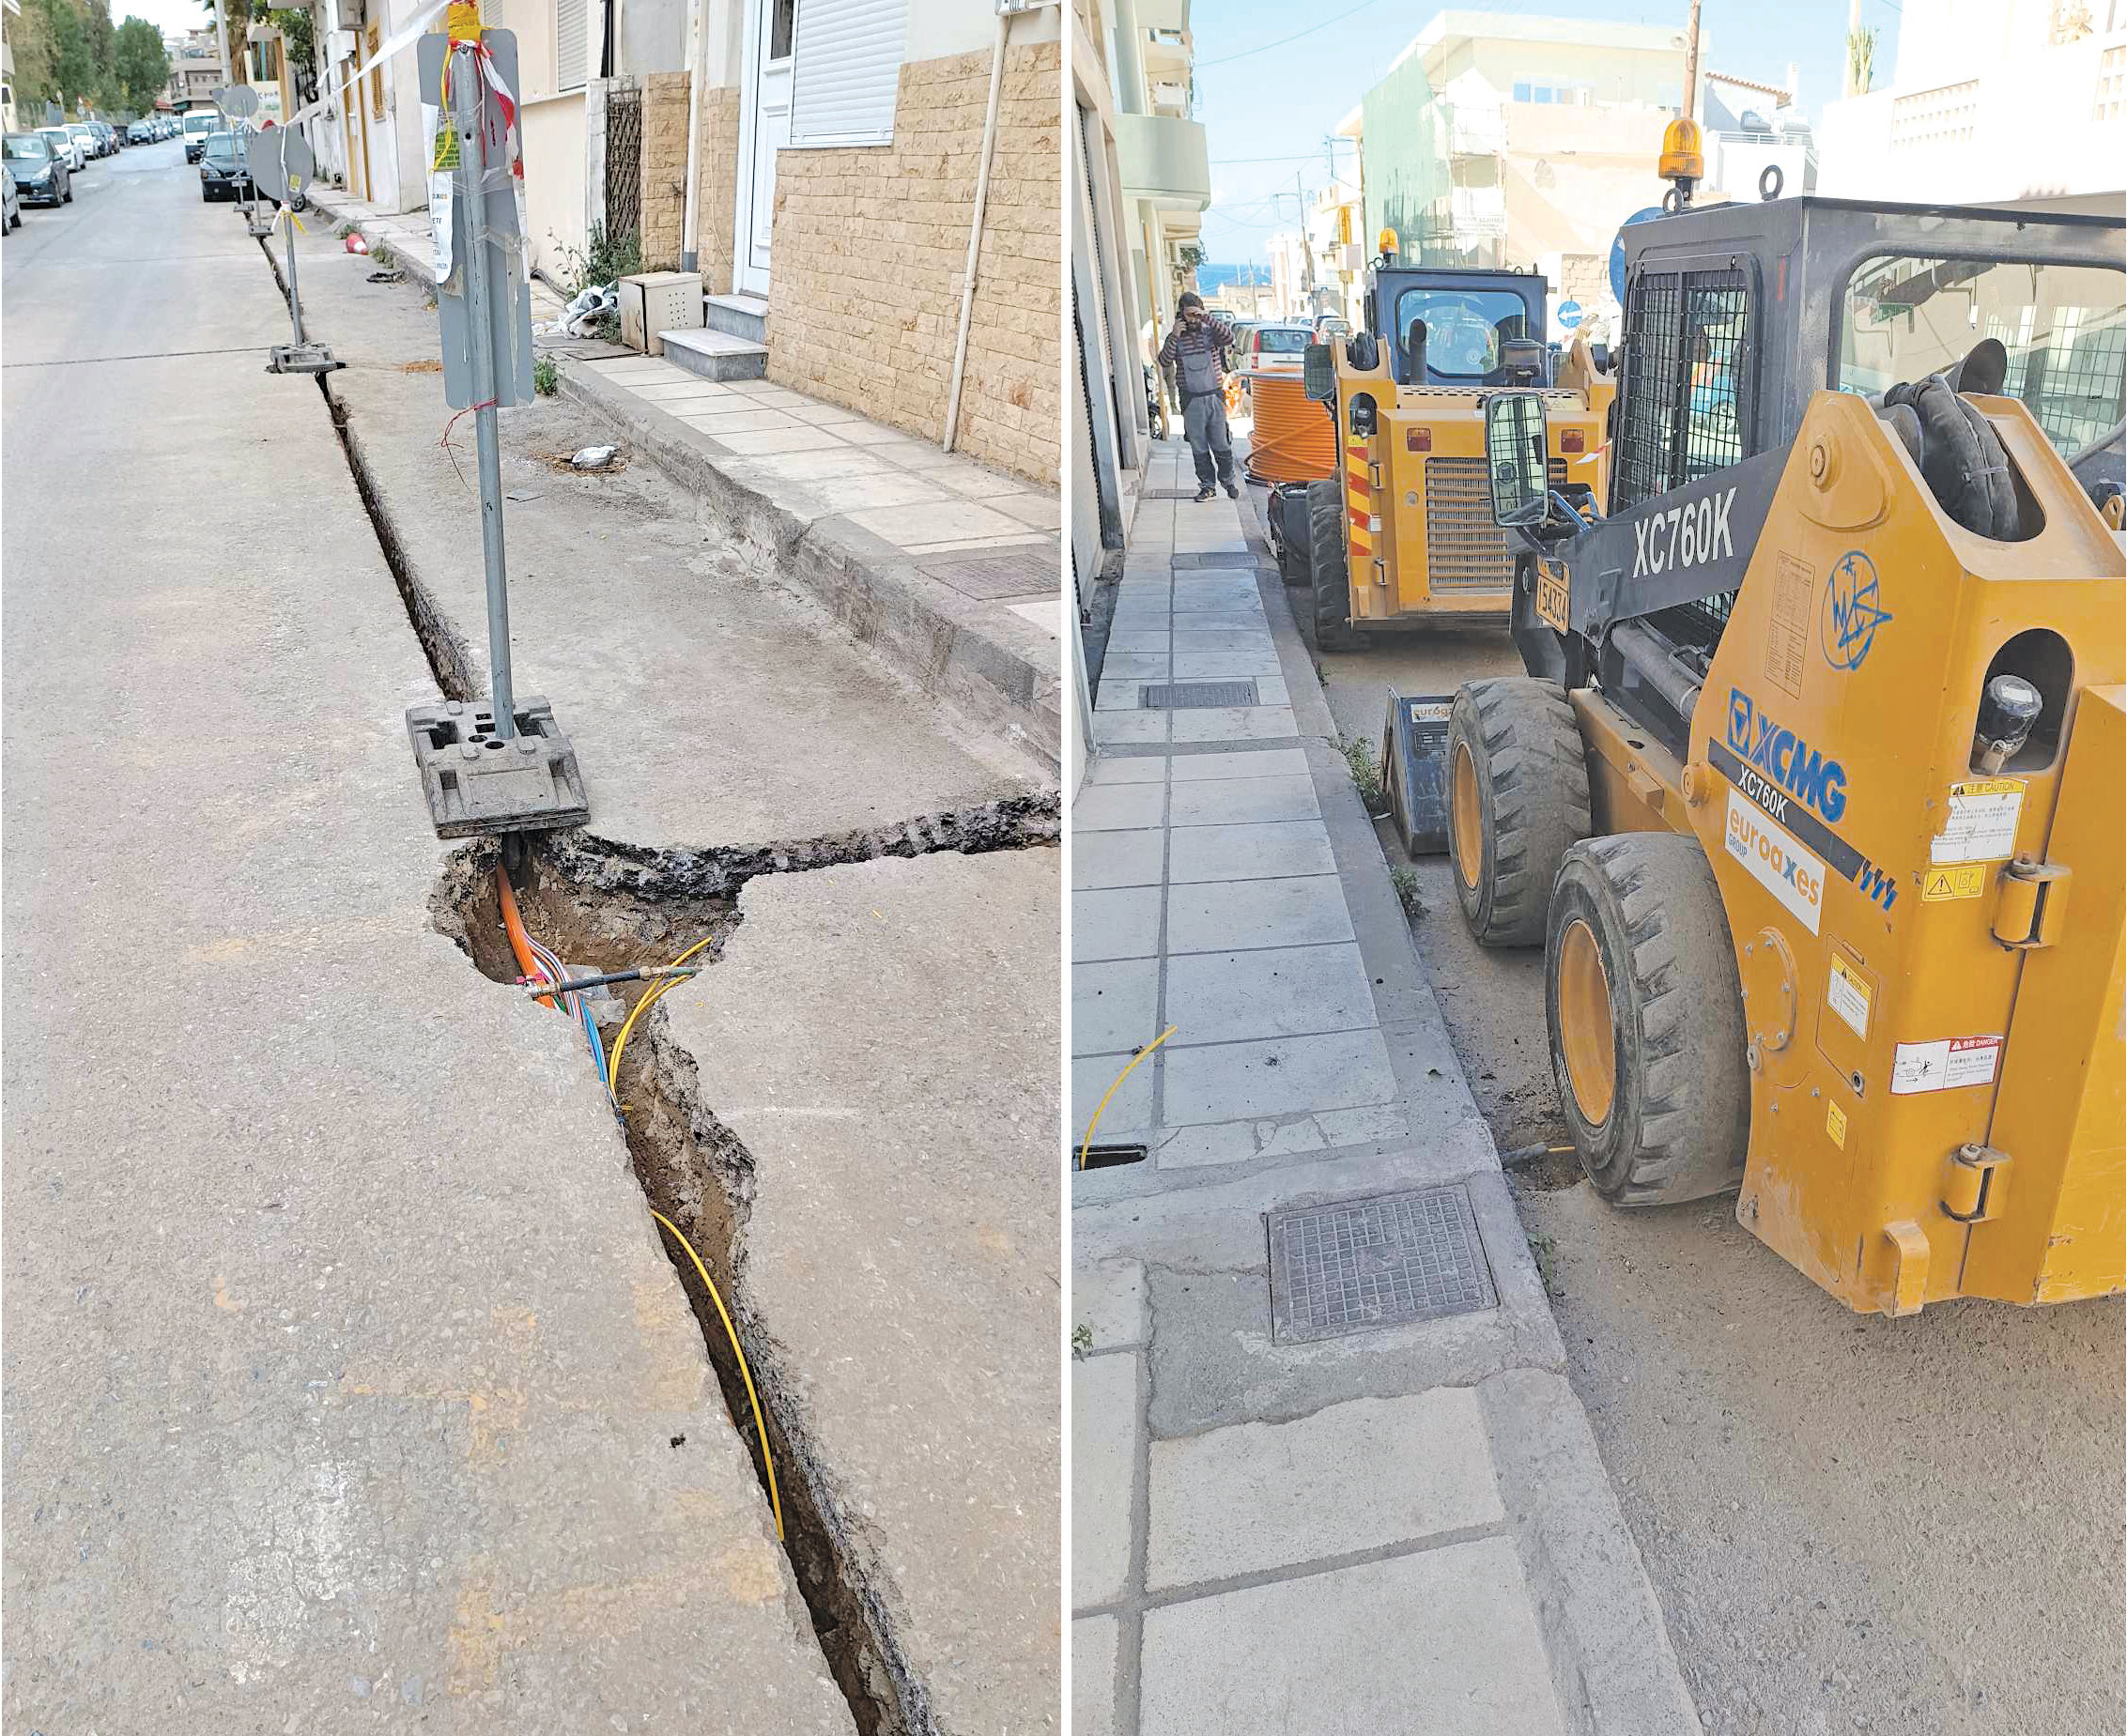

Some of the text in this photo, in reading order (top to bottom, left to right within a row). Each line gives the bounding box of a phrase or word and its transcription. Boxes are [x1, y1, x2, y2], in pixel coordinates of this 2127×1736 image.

[1632, 486, 1737, 578] XC760K
[1737, 763, 1789, 823] XC760K
[1748, 712, 1847, 823] XCMG
[1985, 782, 2015, 792] CAUTION
[1728, 833, 1748, 857] GROUP
[1730, 807, 1820, 906] euroaxes
[1976, 1037, 1998, 1047] DANGER
